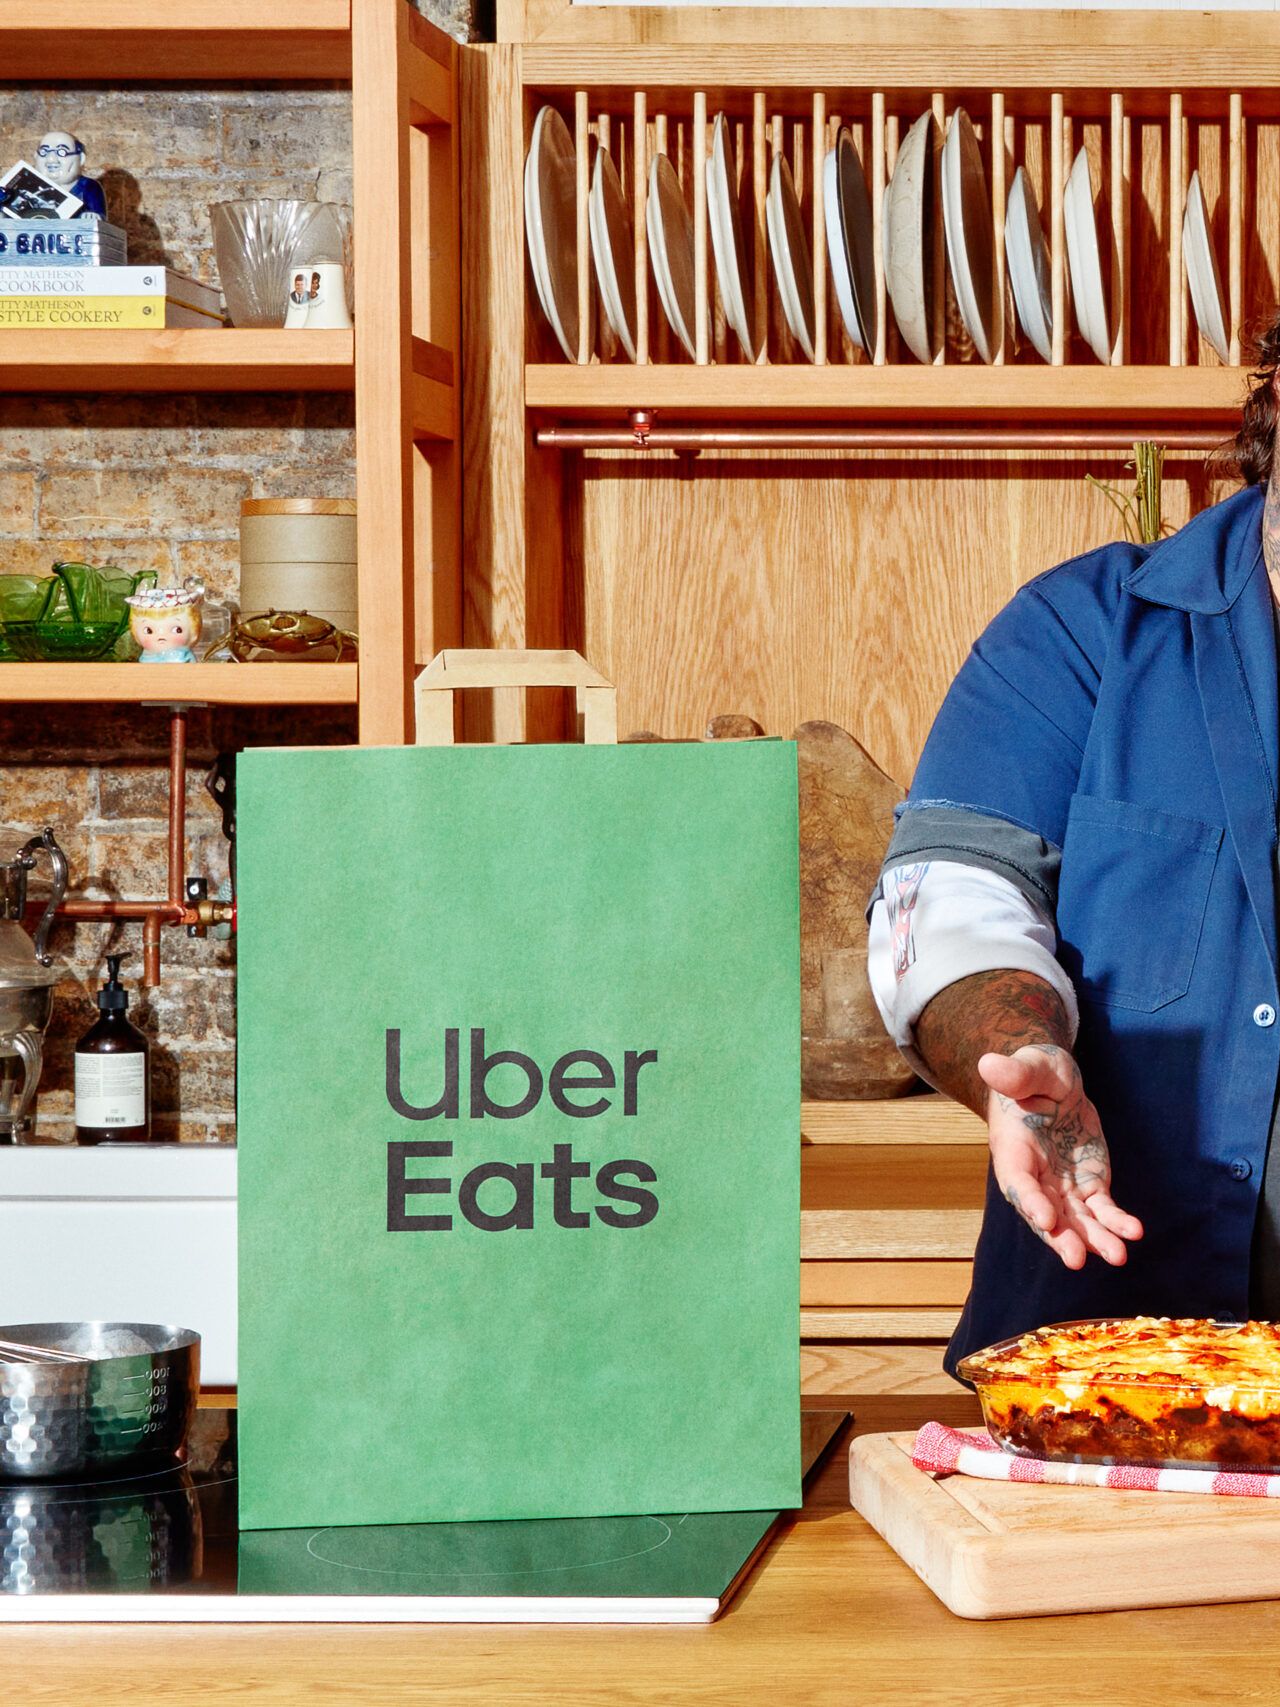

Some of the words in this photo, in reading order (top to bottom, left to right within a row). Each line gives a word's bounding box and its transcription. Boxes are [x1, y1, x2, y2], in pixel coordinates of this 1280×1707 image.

[16, 233, 83, 254] BAIL!
[24, 270, 85, 279] MATHESON
[0, 280, 84, 292] COOKBOOK
[23, 300, 84, 310] MATHESON
[49, 310, 123, 323] COOKERY
[386, 1027, 658, 1121] Uber
[386, 1140, 659, 1232] Eats
